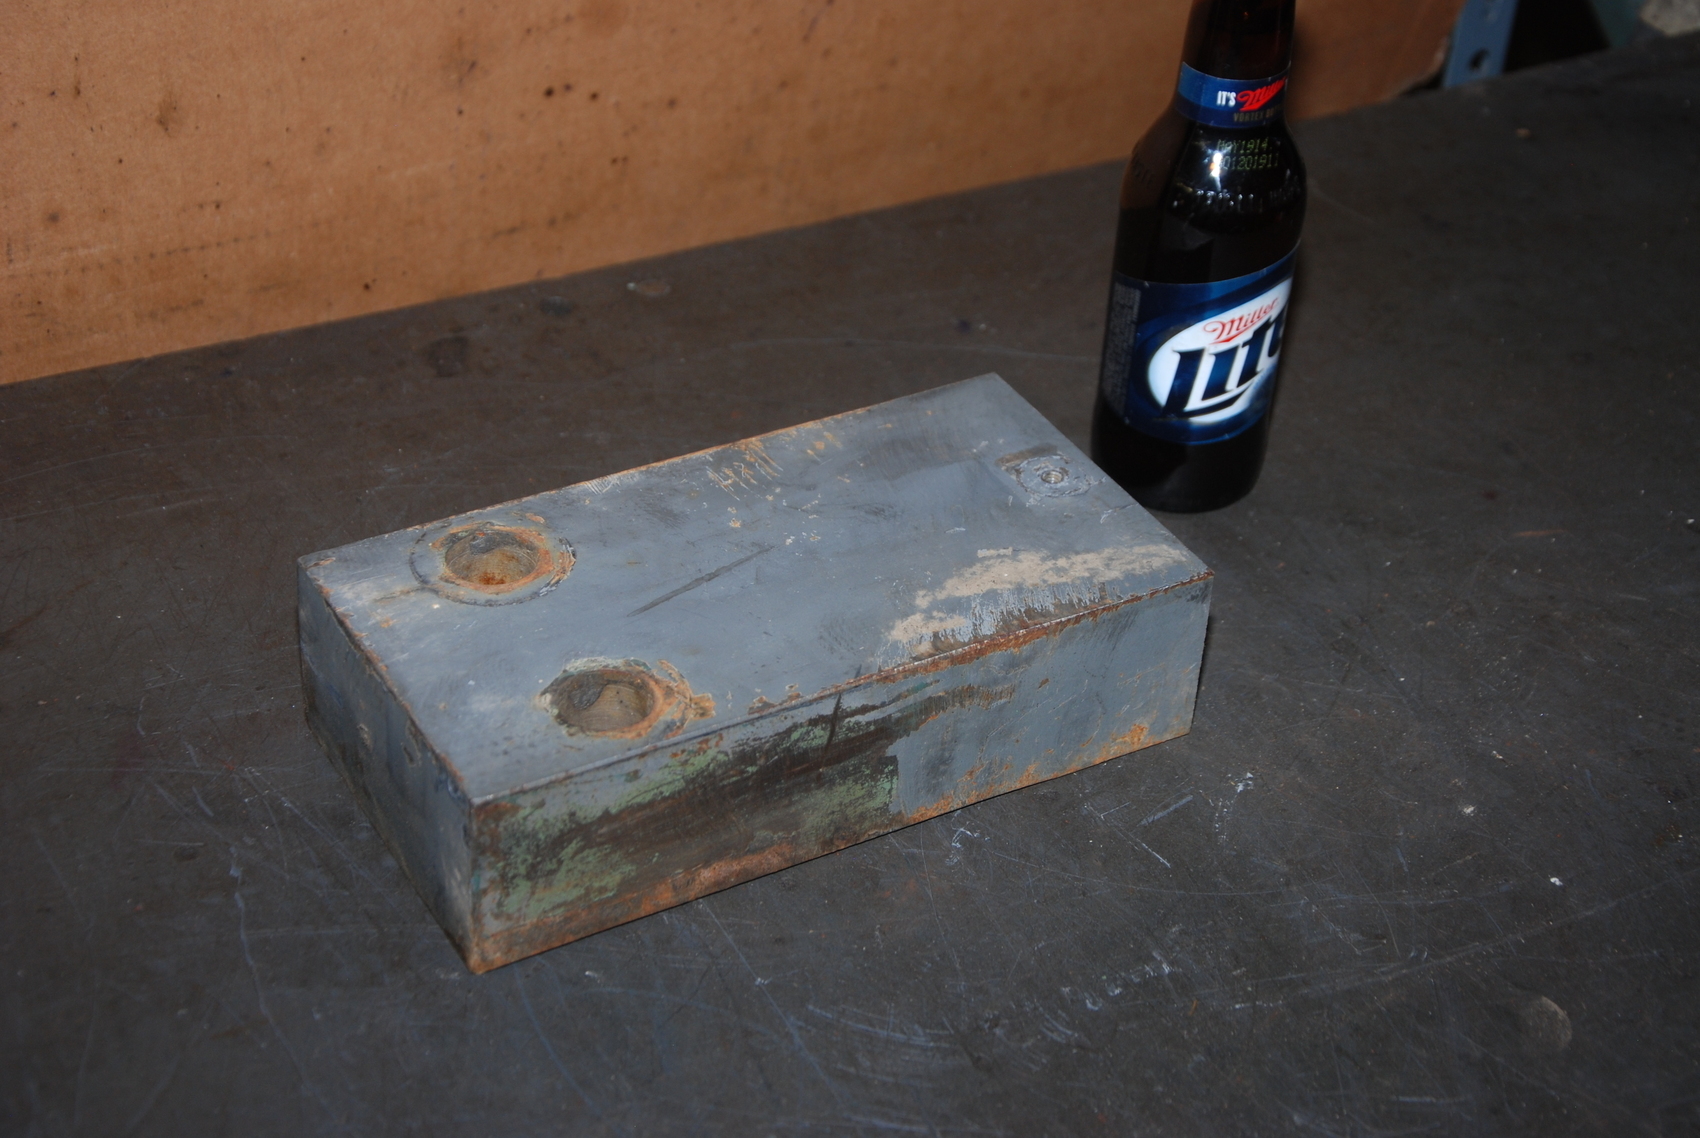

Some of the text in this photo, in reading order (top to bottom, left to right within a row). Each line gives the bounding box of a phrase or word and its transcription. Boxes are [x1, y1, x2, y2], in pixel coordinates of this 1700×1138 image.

[1216, 90, 1237, 107] IT'S
[1233, 110, 1264, 122] VORTEX
[1203, 298, 1281, 345] Miller
